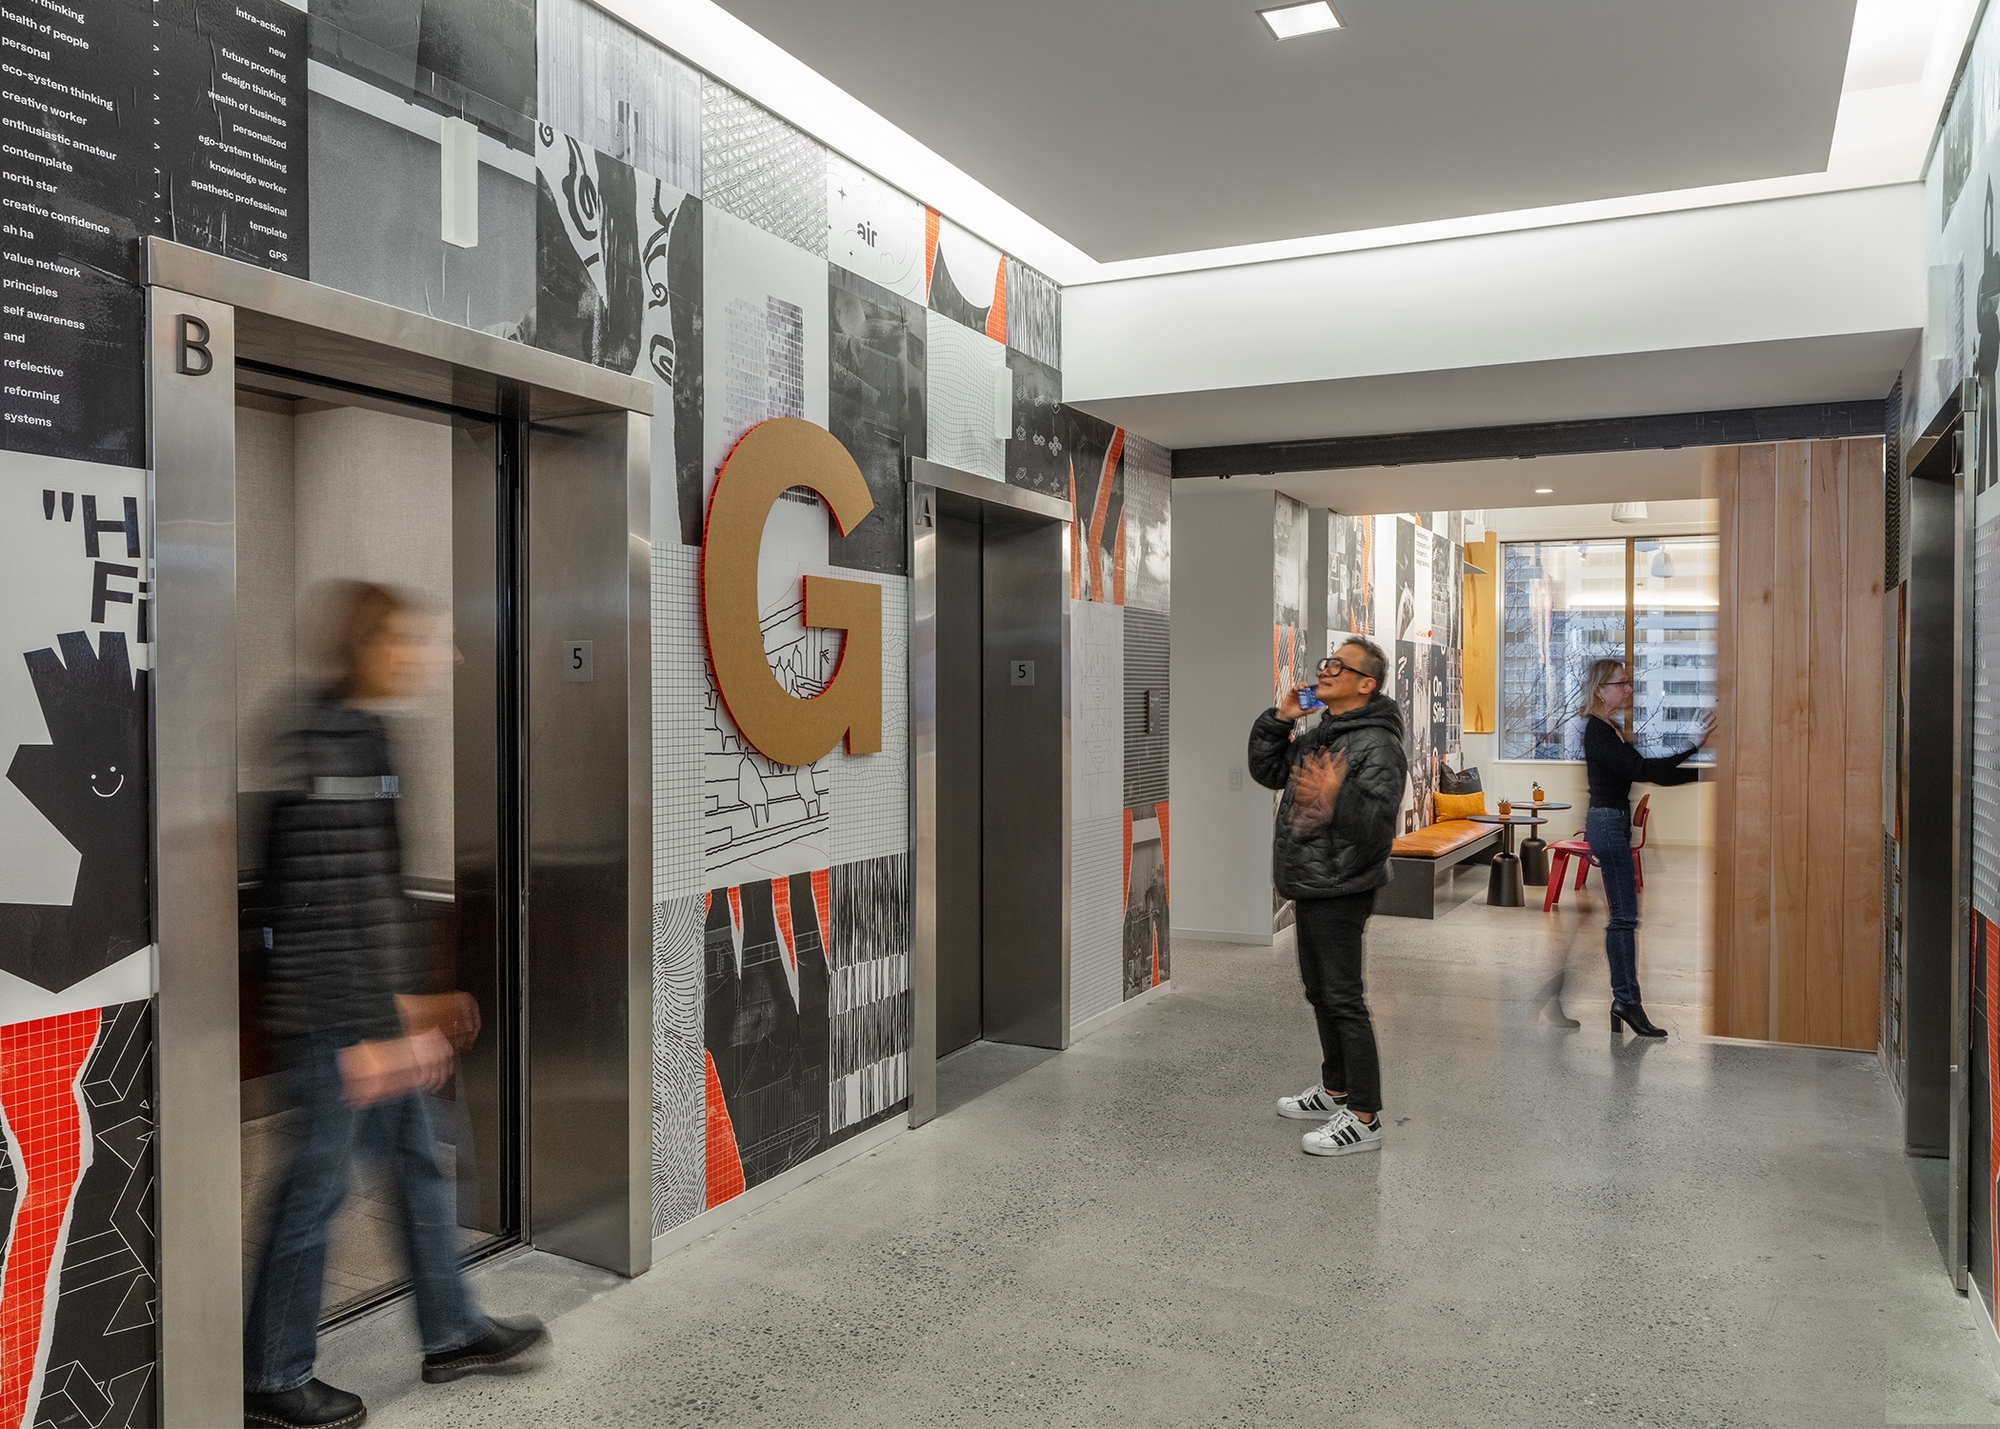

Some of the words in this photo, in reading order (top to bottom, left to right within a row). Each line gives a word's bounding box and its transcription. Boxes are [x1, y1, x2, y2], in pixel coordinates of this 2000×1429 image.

[40, 0, 85, 24] thinking
[236, 6, 286, 37] intra-action
[1, 7, 37, 30] health
[39, 25, 51, 35] of
[53, 30, 89, 49] people
[2, 36, 50, 61] personal
[269, 47, 286, 59] new
[221, 48, 250, 66] future
[251, 62, 286, 84] proofing
[2, 64, 68, 93] eco-system
[70, 86, 113, 111] thinking
[221, 72, 251, 90] design
[252, 84, 287, 106] thinking
[2, 91, 48, 112] creative
[50, 107, 87, 125] worker
[207, 86, 237, 108] wealth
[238, 103, 248, 112] of
[249, 105, 287, 127] business
[2, 117, 71, 146] enthusiastic
[72, 141, 117, 160] amateur
[233, 124, 286, 149] personalized
[2, 144, 73, 172] contemplate
[198, 135, 251, 159] ego-system
[252, 153, 287, 174] thinking
[3, 171, 34, 187] north
[36, 181, 58, 193] star
[210, 160, 257, 184] knowledge
[258, 179, 287, 194] worker
[191, 180, 234, 199] apathetic
[235, 194, 287, 217] professional
[3, 198, 49, 217] creative
[50, 212, 110, 234] confidence
[3, 224, 17, 235] ah
[20, 227, 34, 239] ha
[249, 221, 287, 239] template
[857, 220, 878, 248] air
[3, 252, 34, 266] value
[36, 260, 81, 278] network
[269, 249, 288, 262] GPS
[3, 279, 58, 298] principles
[3, 306, 25, 316] self
[26, 311, 85, 330] awareness
[3, 332, 25, 343] and
[176, 313, 213, 376] B
[4, 359, 64, 377] refelective
[4, 386, 60, 404] reforming
[4, 413, 52, 427] systems
[915, 495, 933, 528] A
[702, 417, 882, 766] G
[573, 648, 582, 669] 5
[1018, 664, 1026, 678] 5
[1432, 675, 1443, 697] On
[1432, 701, 1446, 724] Site
[374, 791, 405, 799] DOVETA
